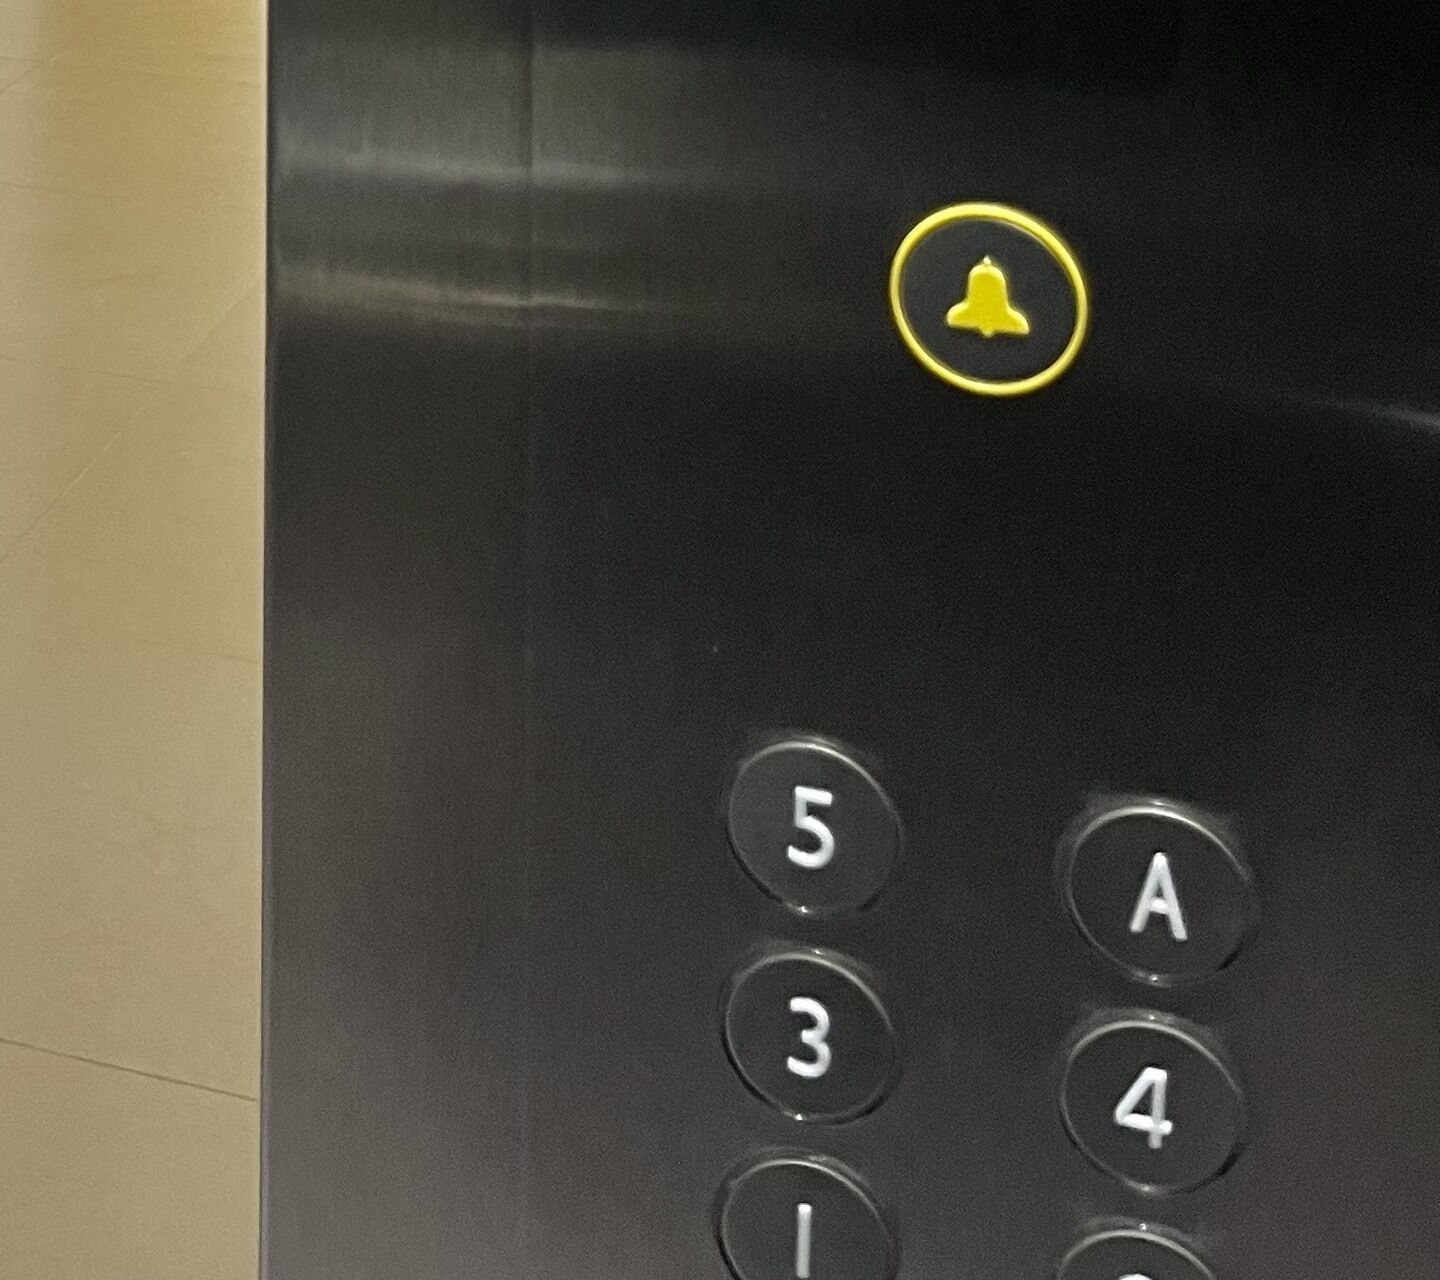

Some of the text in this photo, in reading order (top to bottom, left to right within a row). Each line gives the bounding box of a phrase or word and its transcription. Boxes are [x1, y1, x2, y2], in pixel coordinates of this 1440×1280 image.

[786, 785, 836, 869] 5
[1129, 851, 1189, 941] A
[786, 996, 831, 1079] 3
[1113, 1066, 1174, 1149] 4
